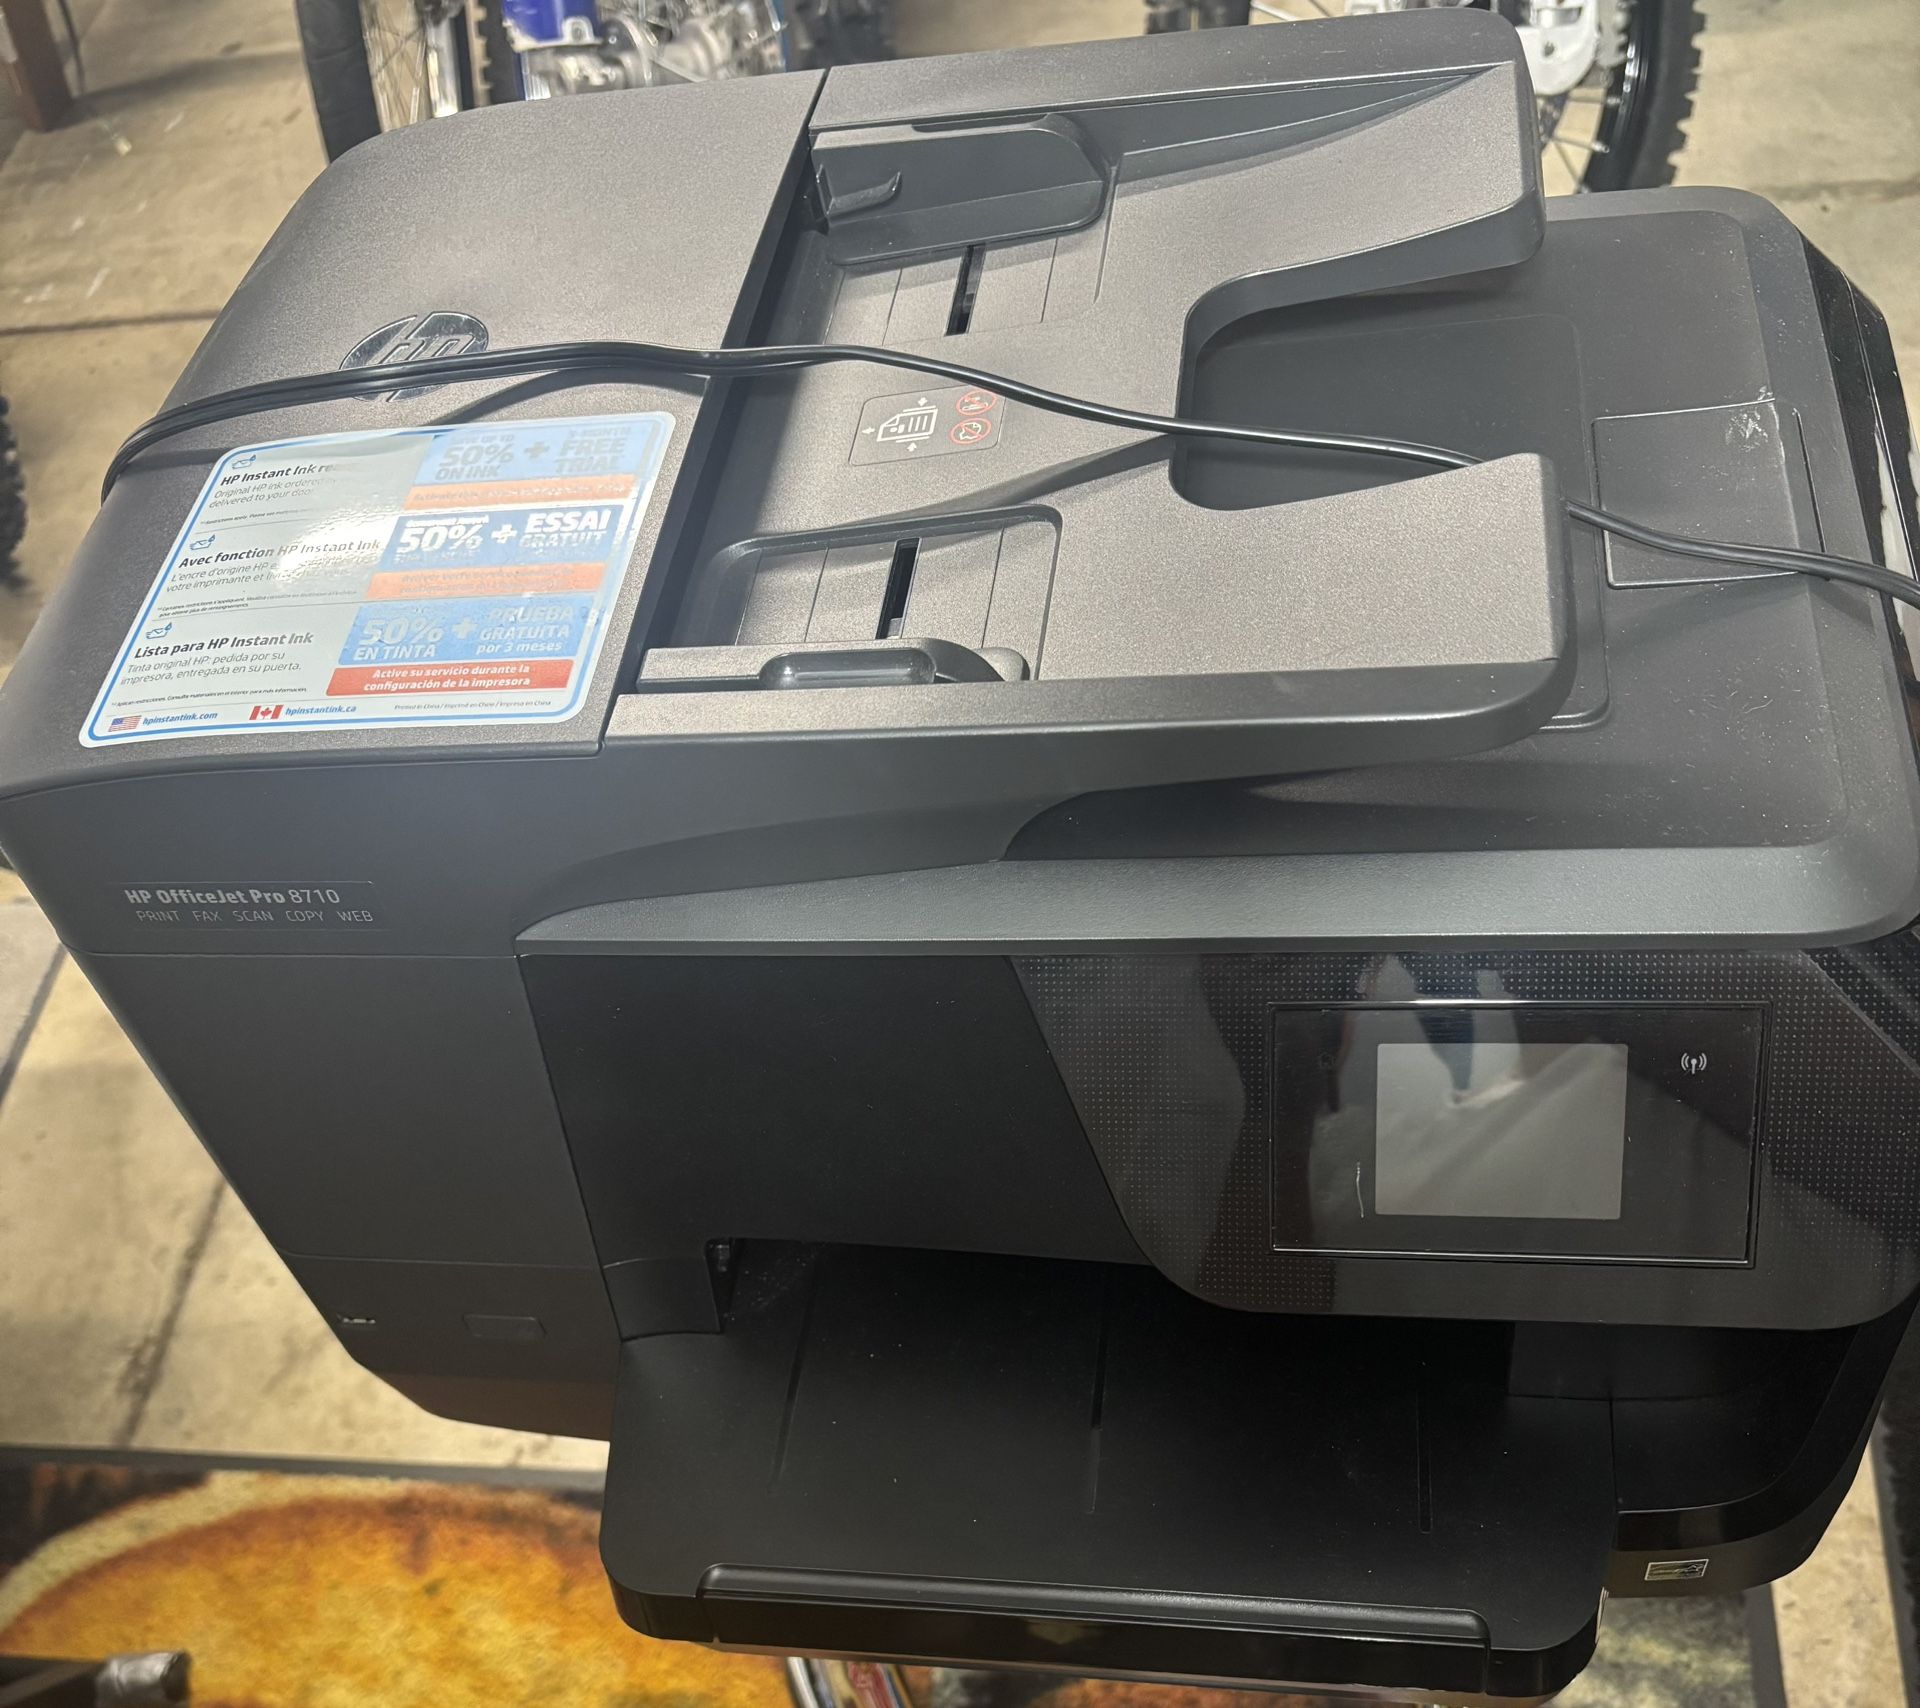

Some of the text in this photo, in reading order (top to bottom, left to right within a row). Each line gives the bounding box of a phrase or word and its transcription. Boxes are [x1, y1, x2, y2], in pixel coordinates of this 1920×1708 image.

[440, 444, 515, 466] 50%
[560, 439, 626, 456] FREE
[555, 455, 624, 473] TRIAL
[220, 474, 240, 486] HP
[241, 466, 292, 483] Instant
[292, 464, 315, 477] Ink
[436, 465, 502, 481] ON INK
[214, 486, 250, 498] Original
[252, 484, 268, 493] HP
[268, 482, 283, 490] ink
[208, 494, 254, 508] delivered
[255, 494, 264, 502] to
[265, 490, 290, 502] your
[524, 510, 612, 533] ESSAI
[396, 524, 518, 552] 50% +
[179, 554, 213, 568] Avec
[214, 548, 274, 564] fonction
[277, 544, 299, 557] HP
[300, 542, 354, 554] Instant
[356, 539, 380, 551] Ink
[171, 570, 207, 582] L'encre
[208, 564, 252, 579] d'origine
[253, 562, 270, 572] HP
[166, 581, 192, 593] votre
[193, 574, 252, 590] imprimante
[253, 574, 266, 582] et
[490, 606, 574, 623] PRUEBA
[360, 616, 444, 646] 50%
[480, 624, 570, 641] GRATUITA
[134, 632, 314, 660] Lista para HP Instant Ink
[353, 644, 437, 661] EN TINTA
[476, 642, 562, 656] por 3 meses
[128, 662, 152, 674] Tinta
[153, 656, 191, 672] original
[212, 652, 249, 665] pedida
[250, 652, 270, 662] por
[272, 651, 286, 660] su
[121, 661, 302, 686] impresora, entregada en su puerta.
[372, 664, 530, 679] Active su servicio durante la
[364, 677, 530, 692] configuración de la impresora
[285, 703, 357, 717] hpinstantink.ca
[142, 711, 218, 727] hpinstantink.com
[124, 889, 341, 904] HP OfficeJet Pro 8710
[136, 910, 374, 922] PRINT FAX SCAN COPY WEB
